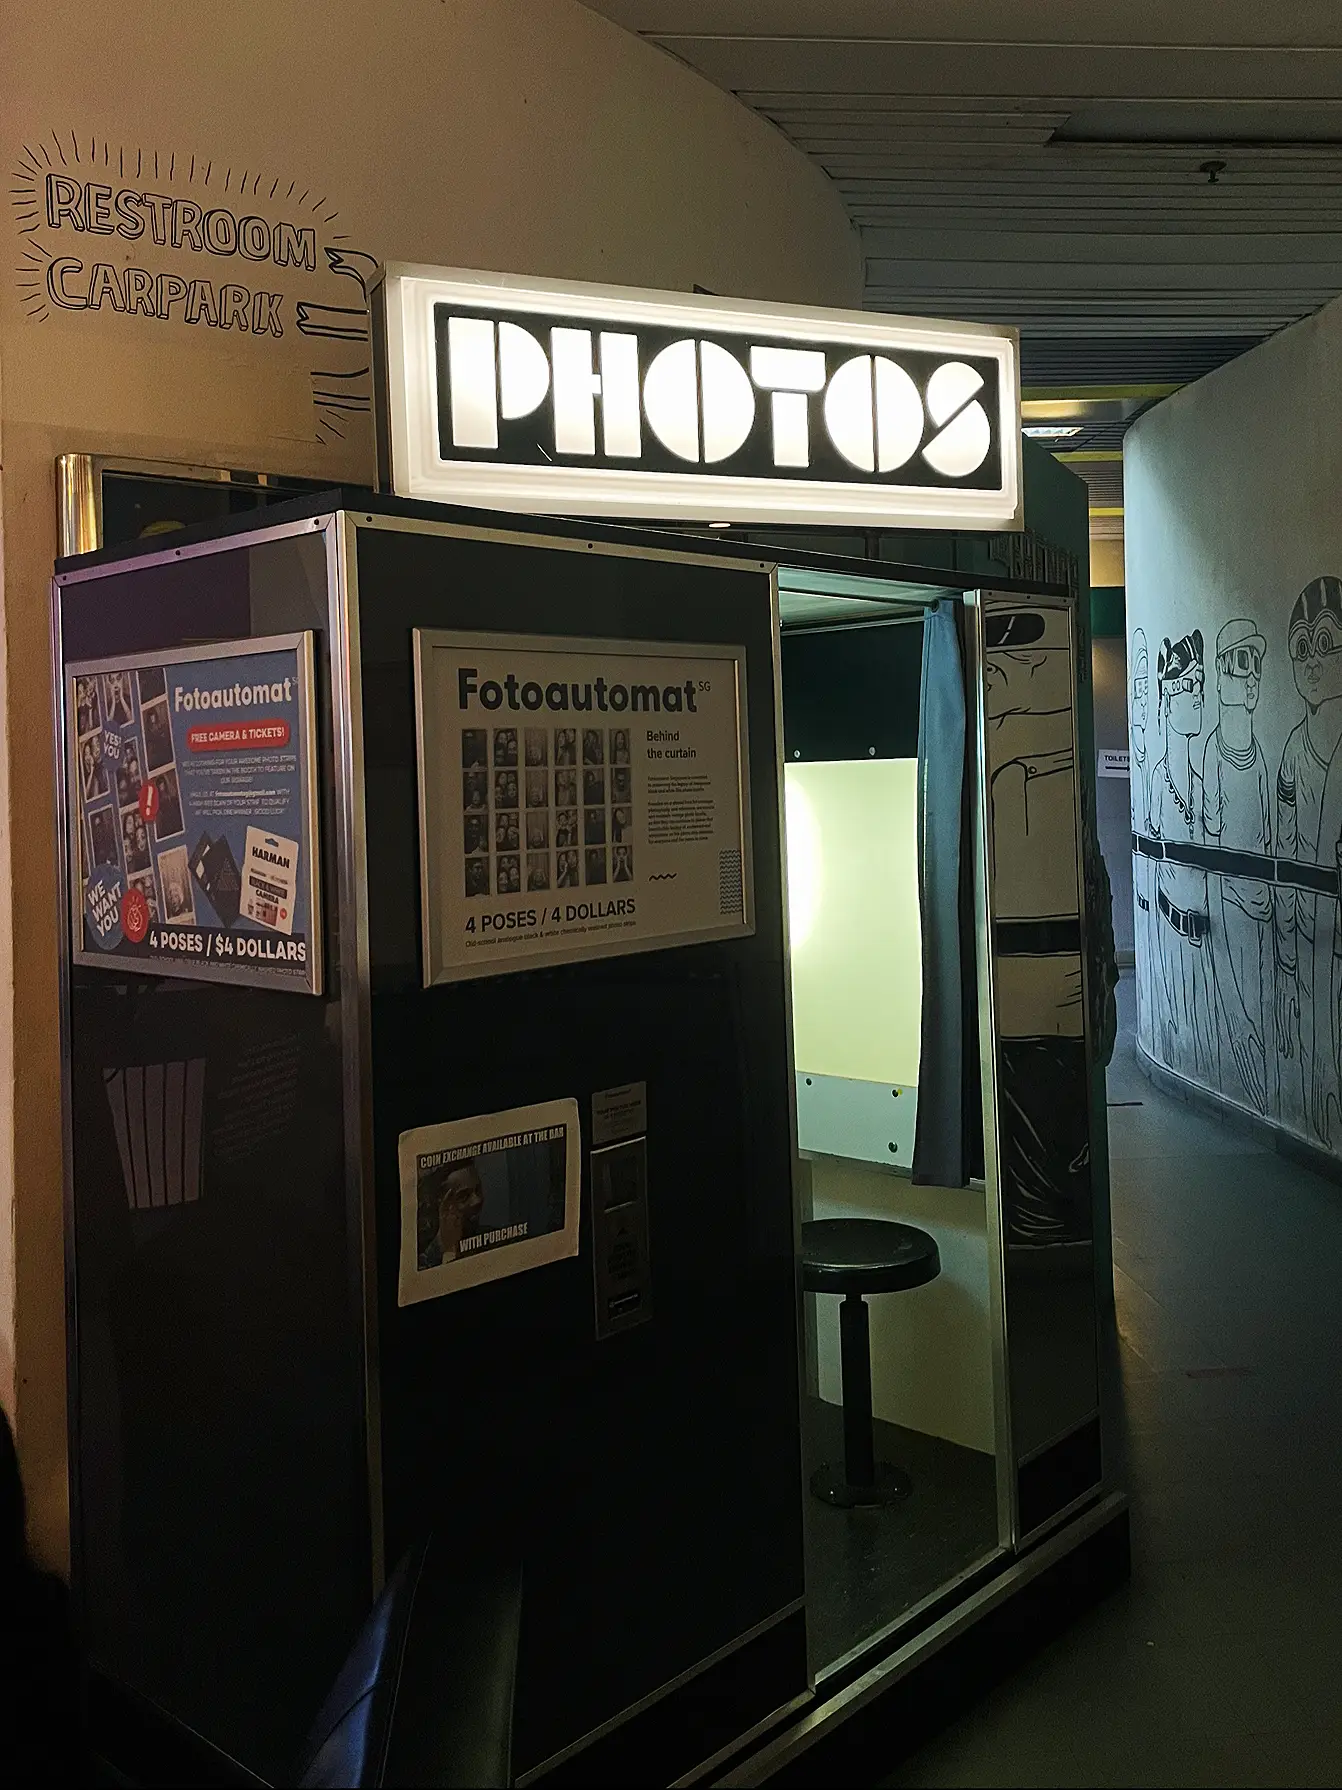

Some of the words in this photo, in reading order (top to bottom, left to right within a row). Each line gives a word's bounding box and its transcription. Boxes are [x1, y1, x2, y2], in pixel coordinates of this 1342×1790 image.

[46, 173, 316, 271] RESTROOM
[47, 257, 284, 337] CARPARK
[447, 316, 992, 477] PHOTOS
[175, 677, 292, 712] Fotoautomat
[458, 668, 697, 713] Fotoautomat
[103, 742, 120, 759] YOU
[191, 733, 207, 743] FREE
[208, 730, 240, 741] CAMERA
[249, 727, 285, 739] TICKETS!
[646, 730, 680, 741] Behind
[647, 748, 662, 759] the
[665, 747, 697, 759] curtain
[252, 846, 290, 868] HARMAN
[88, 880, 105, 906] WE
[92, 881, 121, 922] WANT
[97, 906, 119, 937] YOU
[465, 916, 476, 934] 4
[481, 909, 537, 933] POSES
[551, 906, 562, 923] 4
[566, 898, 636, 922] DOLLARS
[150, 931, 158, 948] 4
[160, 931, 203, 953] POSES
[215, 933, 234, 957] $4
[237, 938, 306, 962] DOLLARS
[421, 1154, 441, 1169] COIN
[442, 1143, 482, 1163] EXCHANGE
[482, 1135, 522, 1153] AVAILABLE
[523, 1133, 532, 1145] AT
[534, 1129, 548, 1142] THE
[460, 1235, 482, 1253] WITH
[483, 1222, 529, 1246] PURCHASE
